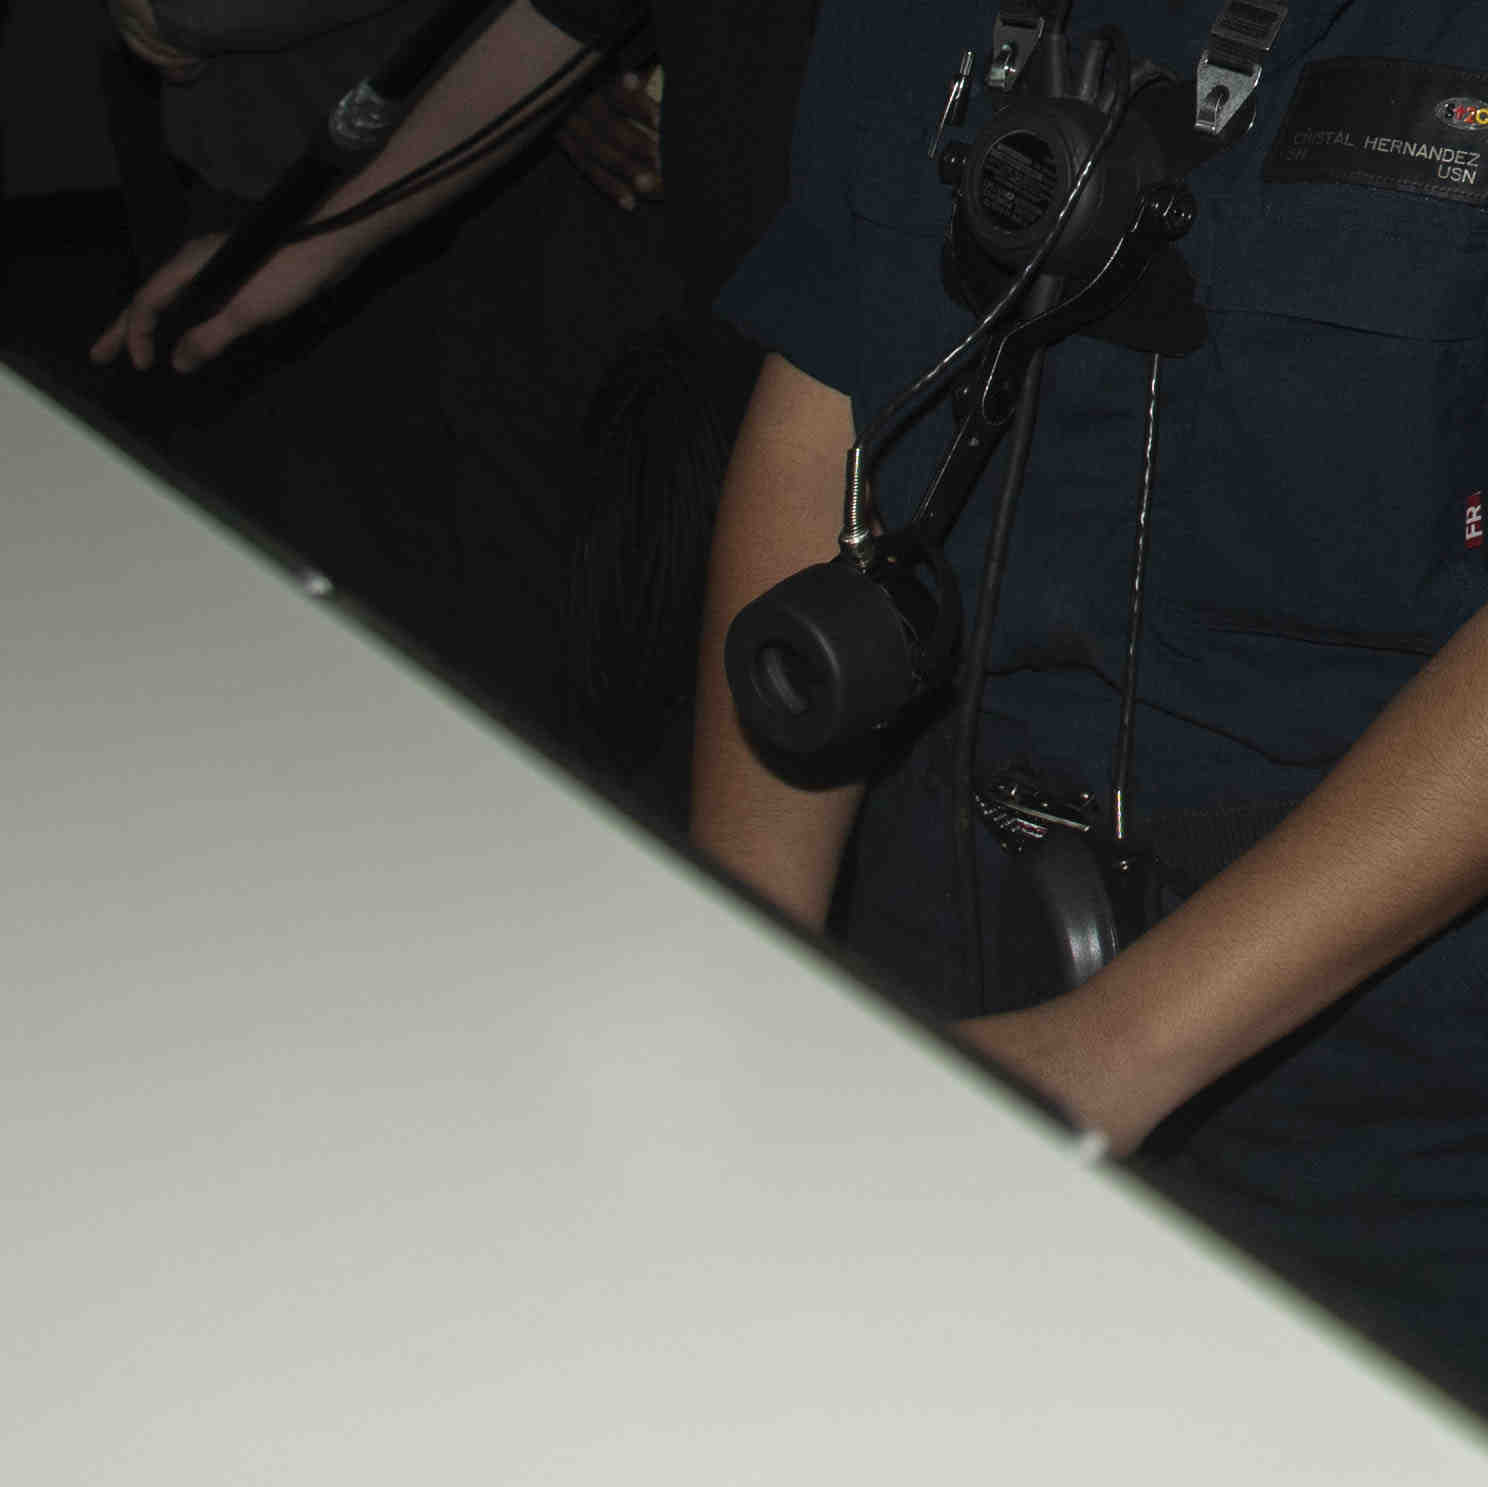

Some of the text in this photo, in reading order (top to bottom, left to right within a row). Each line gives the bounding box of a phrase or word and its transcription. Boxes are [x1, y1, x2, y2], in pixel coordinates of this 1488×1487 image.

[1363, 136, 1480, 166] HERNANDEZ
[1438, 165, 1478, 184] USN
[1465, 504, 1483, 541] FR
